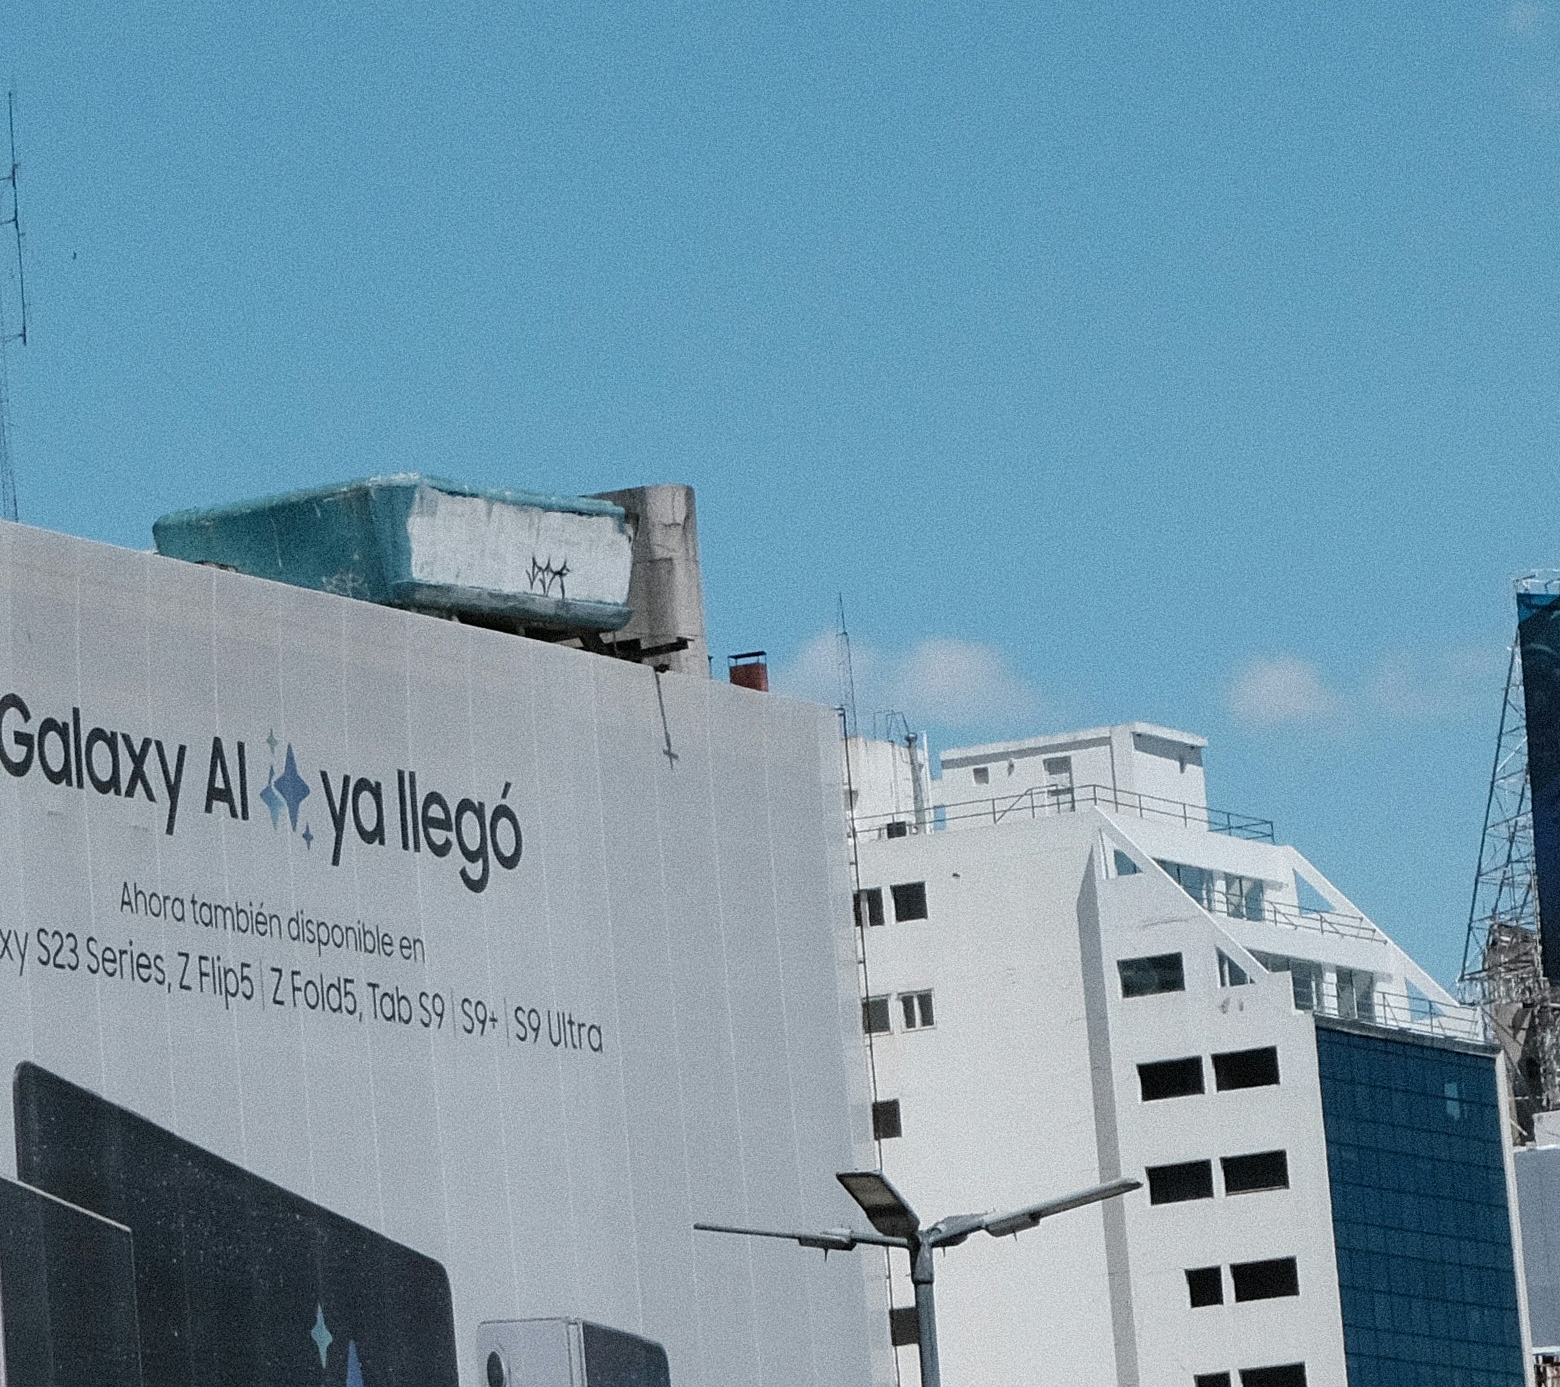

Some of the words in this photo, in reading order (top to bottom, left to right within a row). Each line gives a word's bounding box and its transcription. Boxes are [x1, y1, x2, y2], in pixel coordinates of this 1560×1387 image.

[204, 735, 249, 822] AI
[320, 770, 387, 867] ya
[397, 768, 523, 895] llegó
[120, 881, 186, 923] Ahora
[190, 893, 282, 939] también
[287, 910, 395, 957] disponible
[399, 935, 426, 964] en
[37, 928, 80, 971] S23
[86, 936, 171, 993] Series,
[178, 952, 192, 991] Z
[197, 954, 254, 1010] Flip5
[270, 967, 285, 1006] Z
[290, 970, 363, 1022] Fold5,
[367, 982, 412, 1025] Tab
[419, 991, 445, 1029] S9
[461, 998, 498, 1036] S9+
[514, 1005, 541, 1043] S9
[547, 1009, 604, 1053] Ultra
